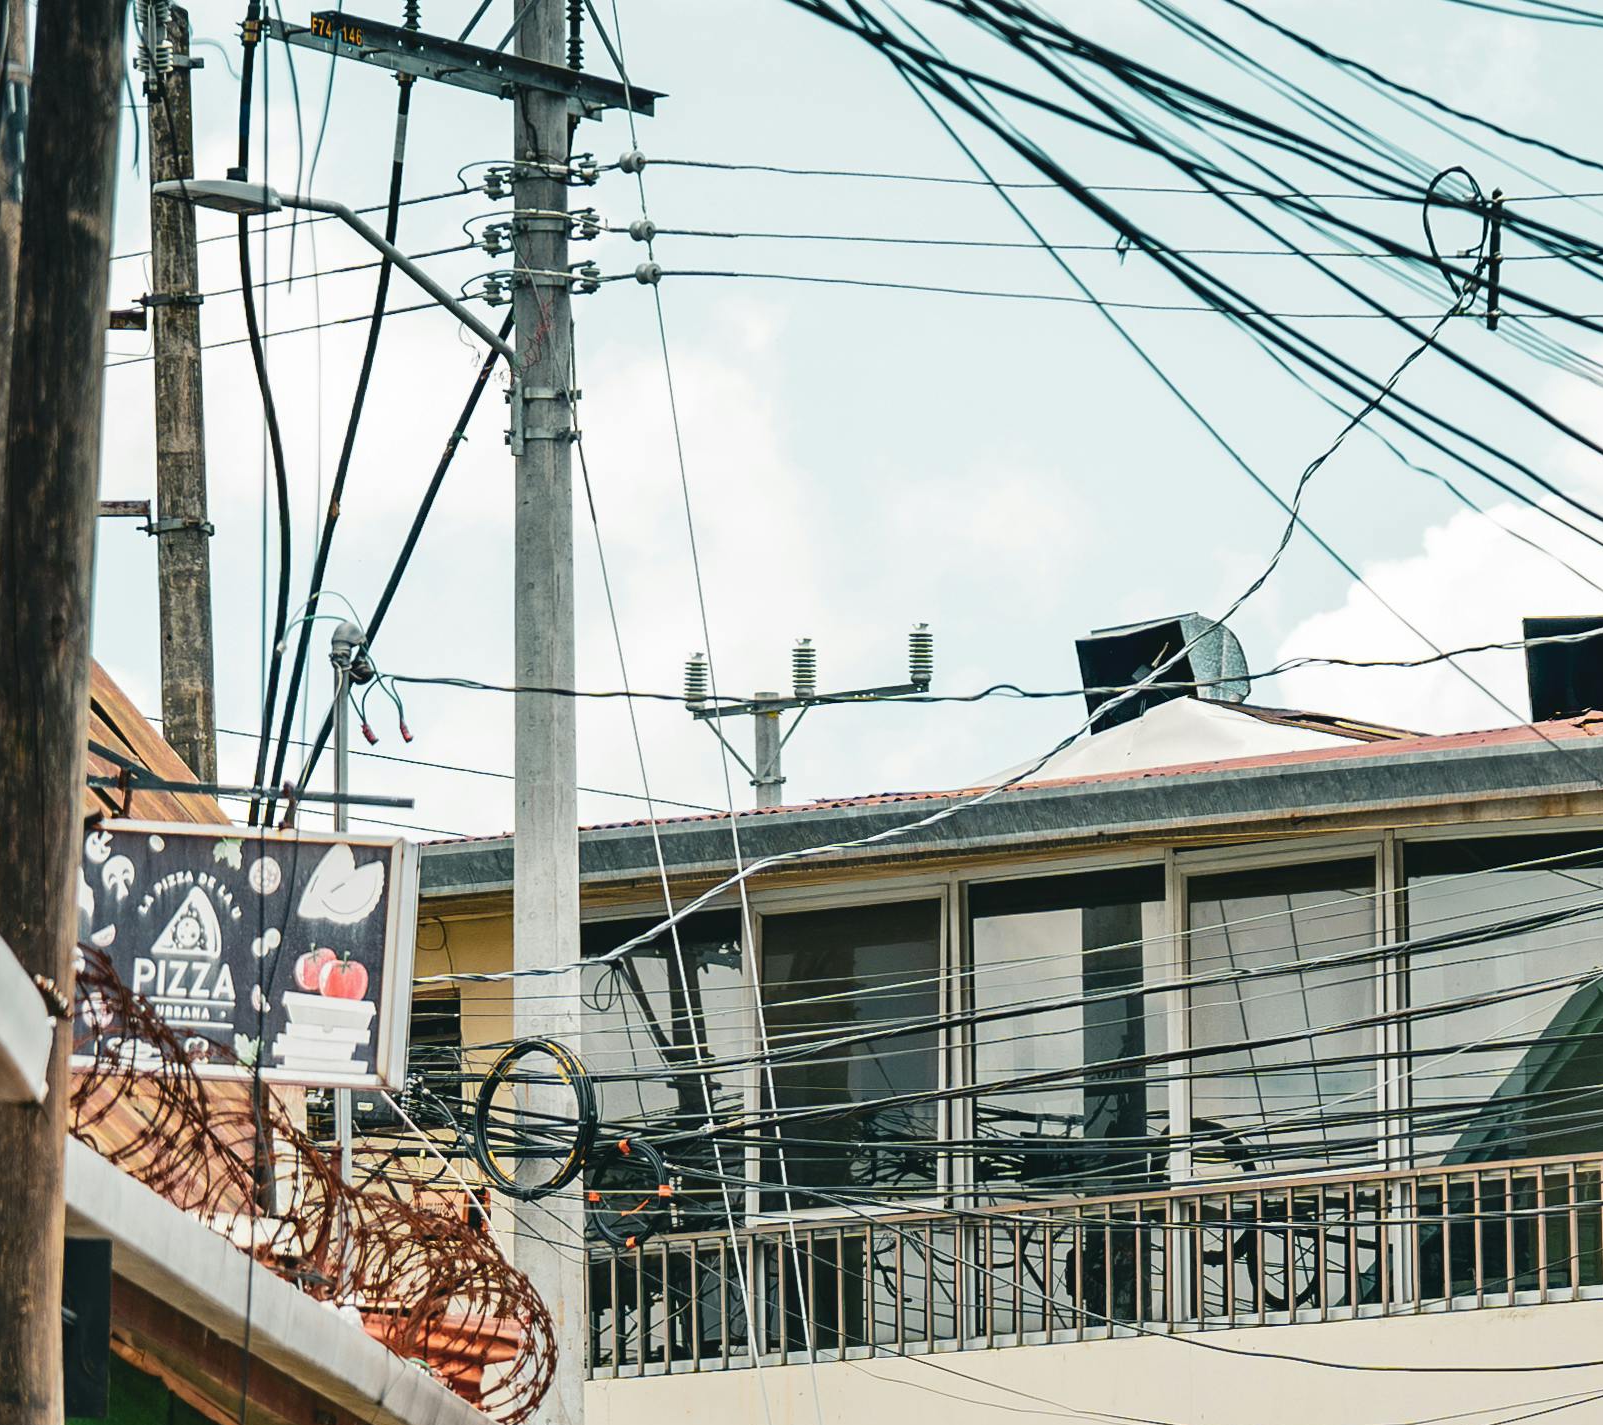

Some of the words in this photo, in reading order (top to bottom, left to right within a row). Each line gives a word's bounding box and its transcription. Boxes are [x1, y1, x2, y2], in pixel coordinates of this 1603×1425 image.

[311, 16, 332, 38] F74
[153, 870, 194, 896] PIZZA
[132, 957, 236, 1001] PIZZA
[155, 1004, 211, 1021] URBANA
